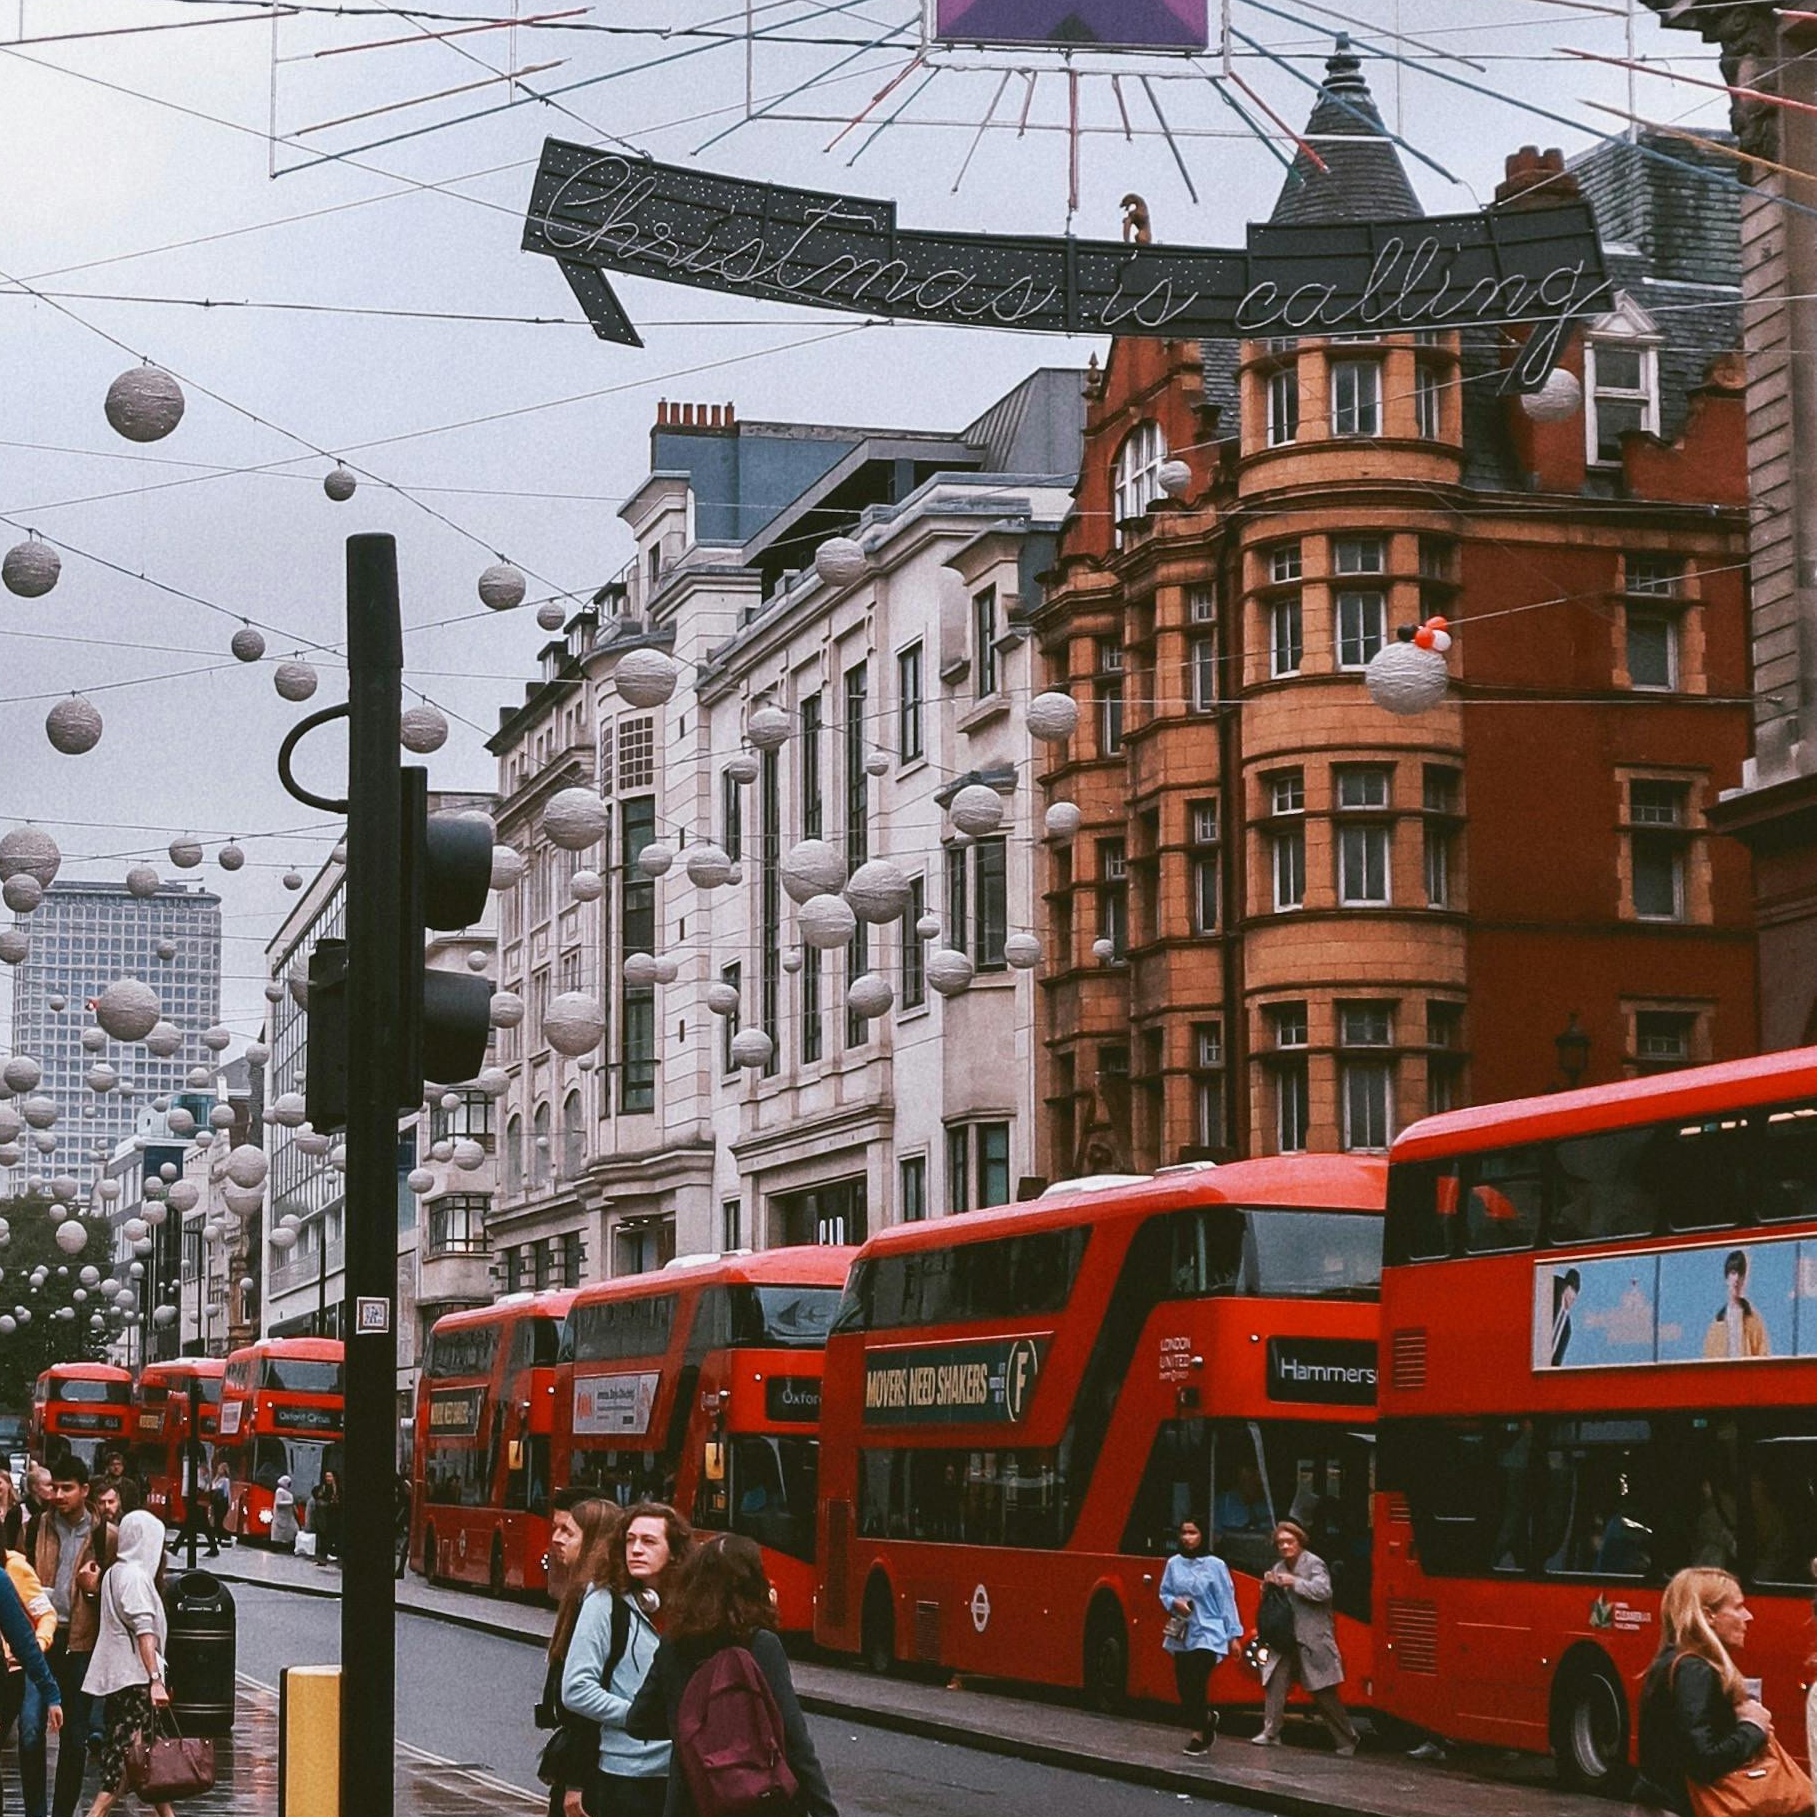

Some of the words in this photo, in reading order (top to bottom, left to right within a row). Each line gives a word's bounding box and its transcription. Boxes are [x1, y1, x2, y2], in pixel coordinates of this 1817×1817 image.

[544, 156, 1058, 322] Christmas
[1100, 247, 1200, 327] is
[1235, 235, 1613, 385] calling
[1160, 1336, 1191, 1352] LONDON
[1159, 1353, 1191, 1369] UNITED
[1280, 1357, 1377, 1384] Hammers
[866, 1368, 908, 1408] MOVERS
[909, 1366, 936, 1406] NEED
[937, 1363, 988, 1406] SHAKERS
